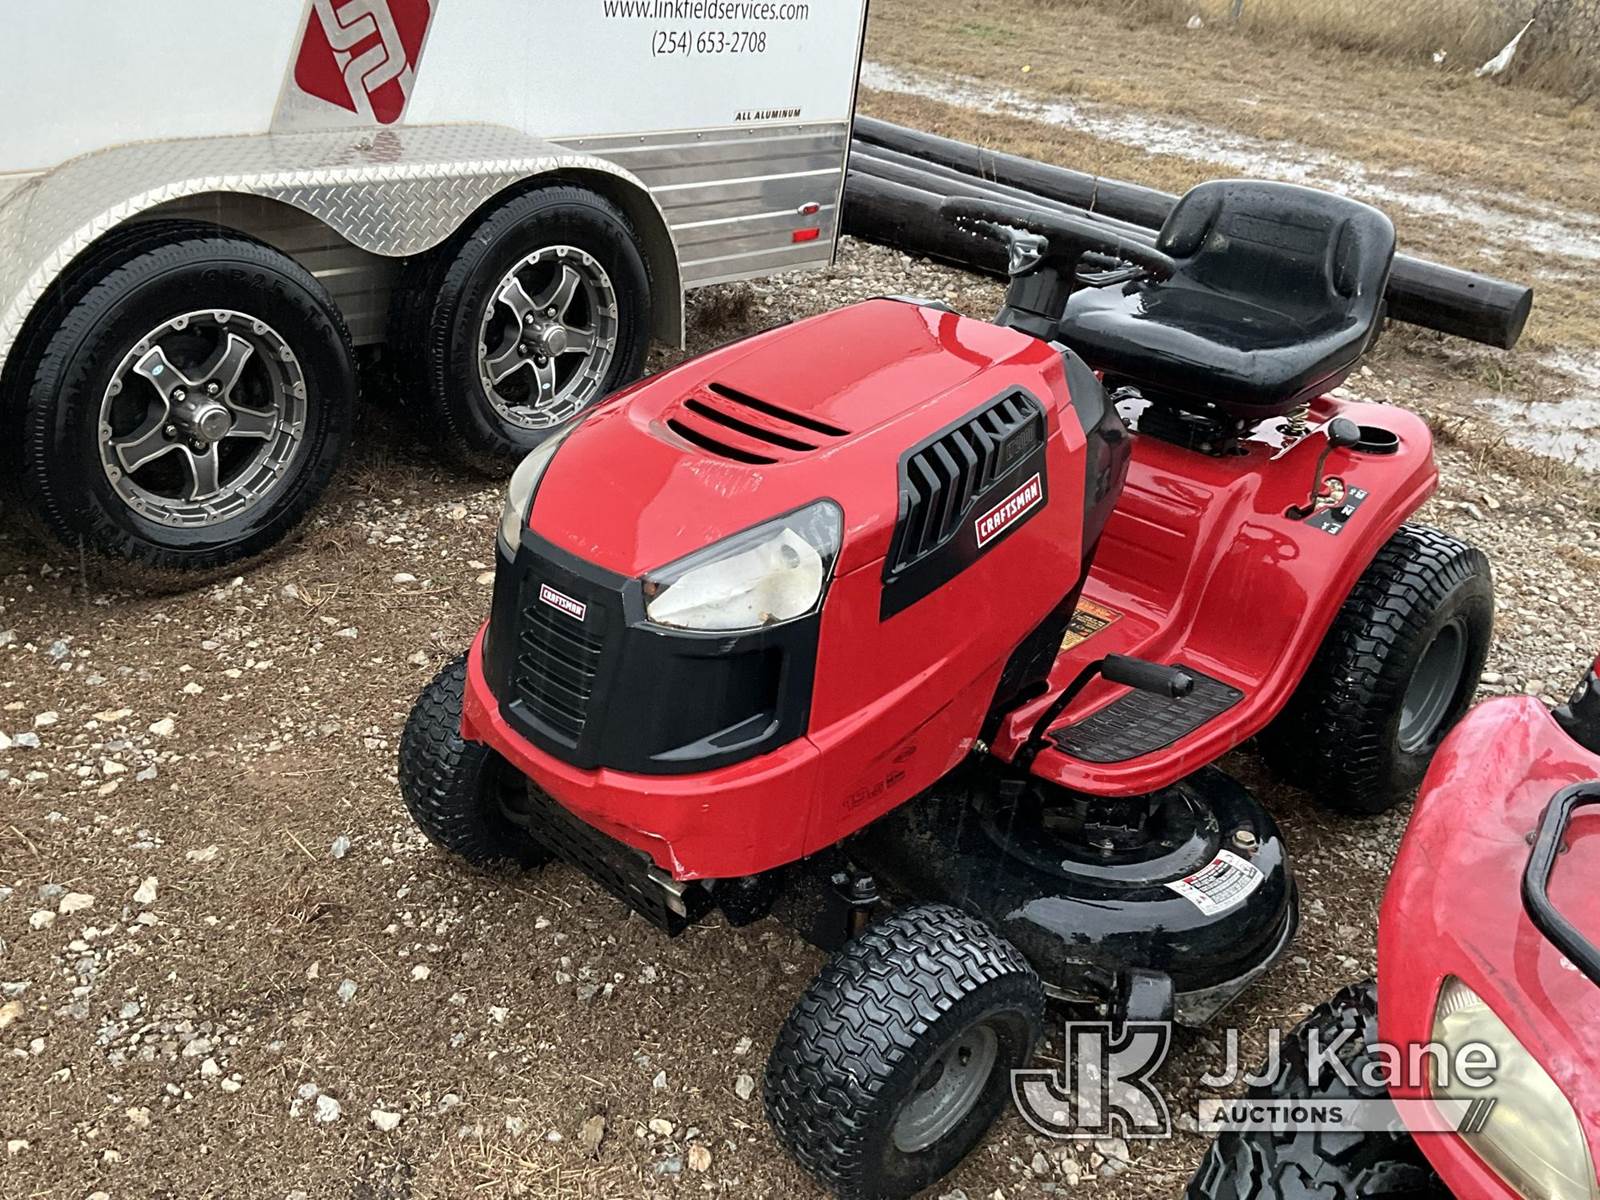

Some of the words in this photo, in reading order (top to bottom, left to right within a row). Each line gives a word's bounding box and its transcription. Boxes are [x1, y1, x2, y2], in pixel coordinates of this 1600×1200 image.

[604, 0, 809, 20] www.linkfieldservices.com
[652, 30, 693, 57] (254)
[696, 31, 767, 54] 653-2708
[735, 110, 752, 121] ALL
[754, 108, 801, 121] ALUMINUM
[980, 486, 1038, 537] CRAFTSMAN
[543, 589, 584, 616] CRAFTSMAN
